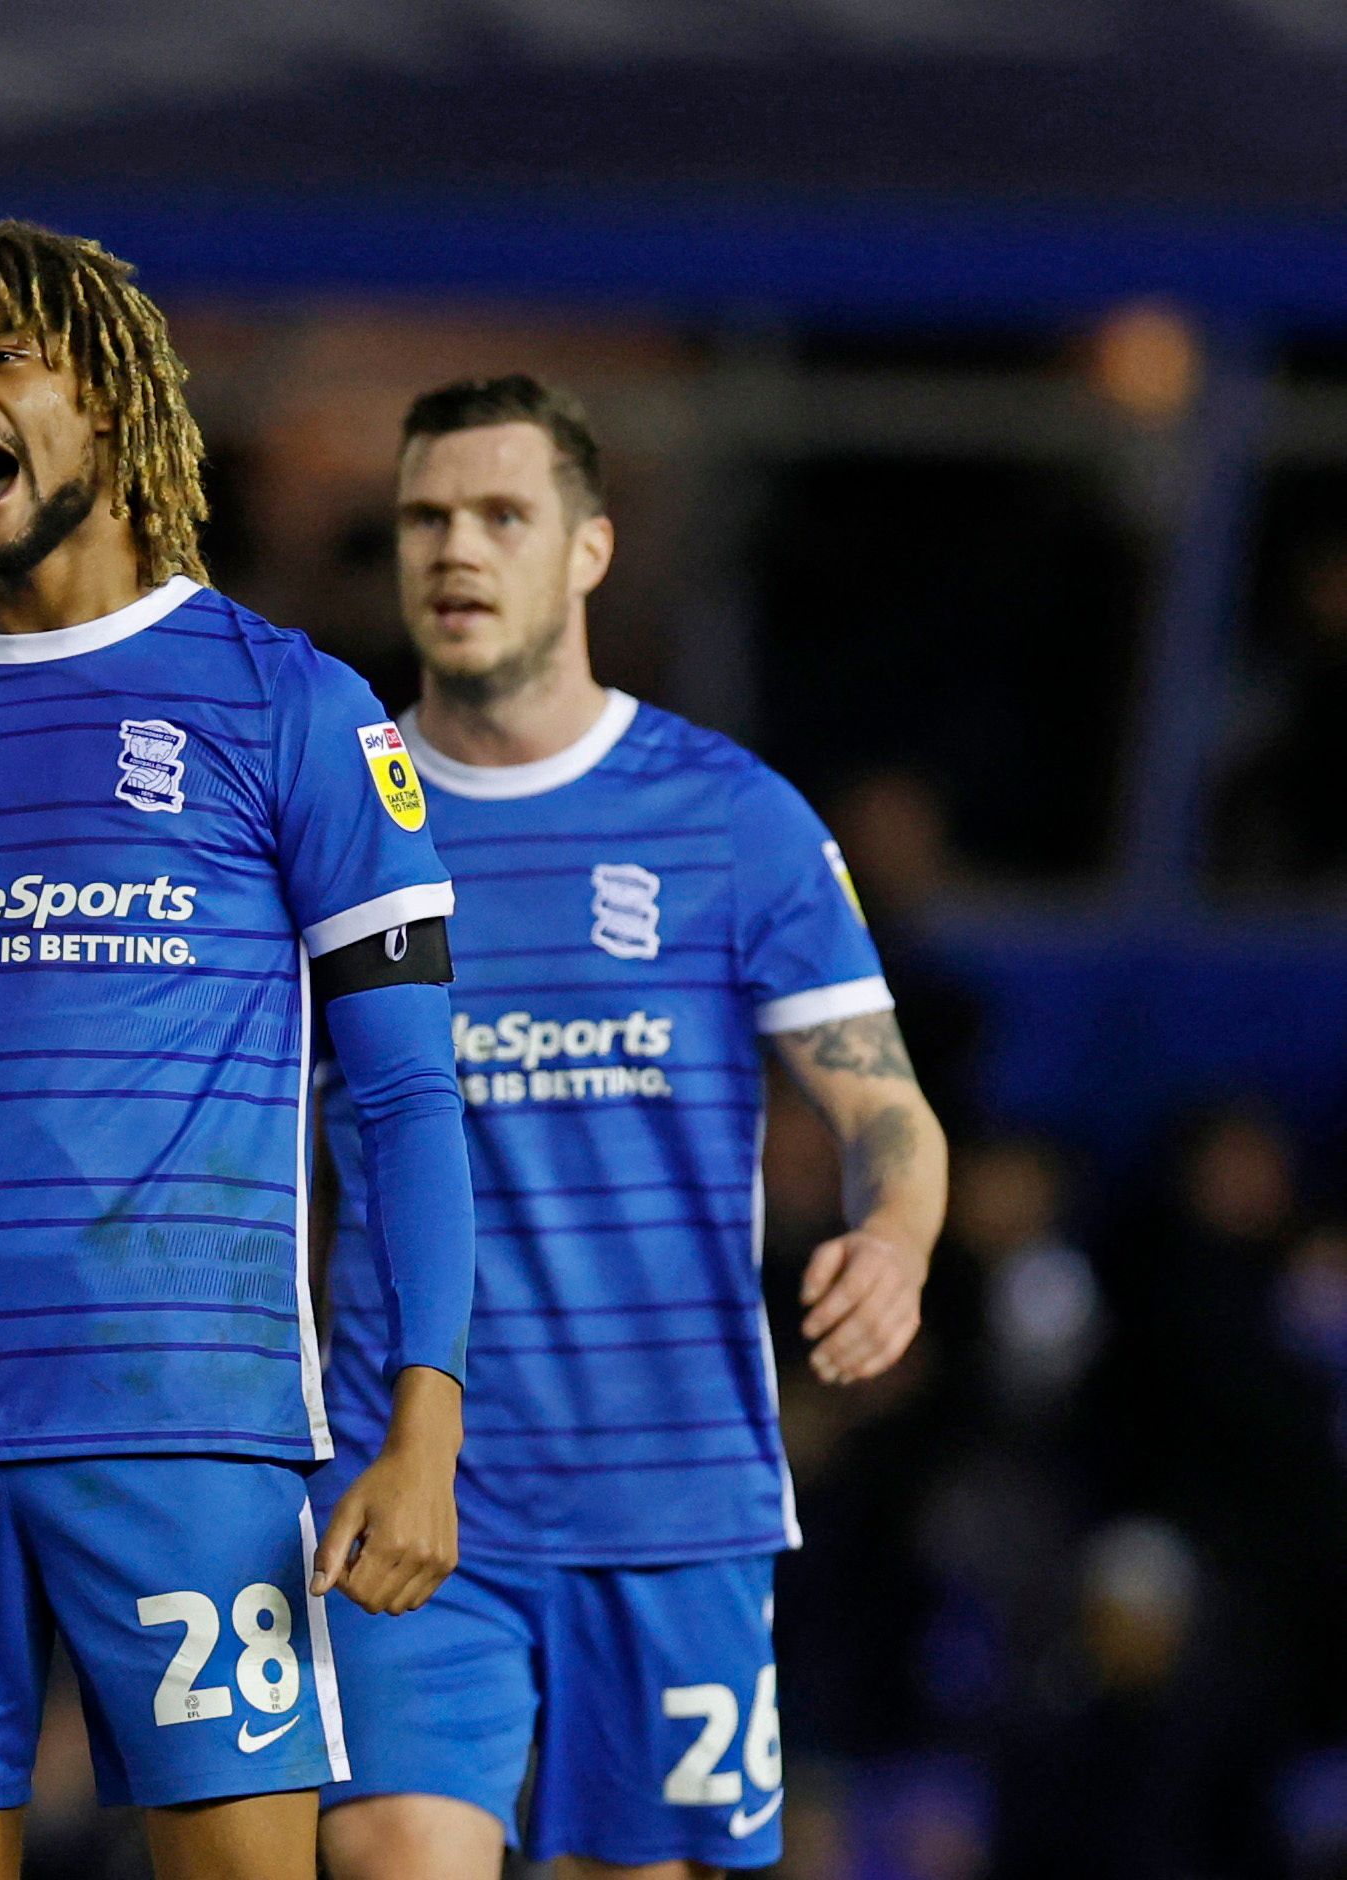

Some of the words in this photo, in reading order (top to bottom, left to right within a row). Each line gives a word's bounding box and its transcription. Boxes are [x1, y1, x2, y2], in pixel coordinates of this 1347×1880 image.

[365, 733, 384, 750] sky
[386, 791, 404, 805] TAKE
[391, 802, 402, 813] TO
[0, 935, 31, 963] IS
[39, 934, 196, 964] BETTING.
[452, 1011, 672, 1070] leSports
[136, 1582, 300, 1727] 28
[662, 1663, 783, 1806] 26
